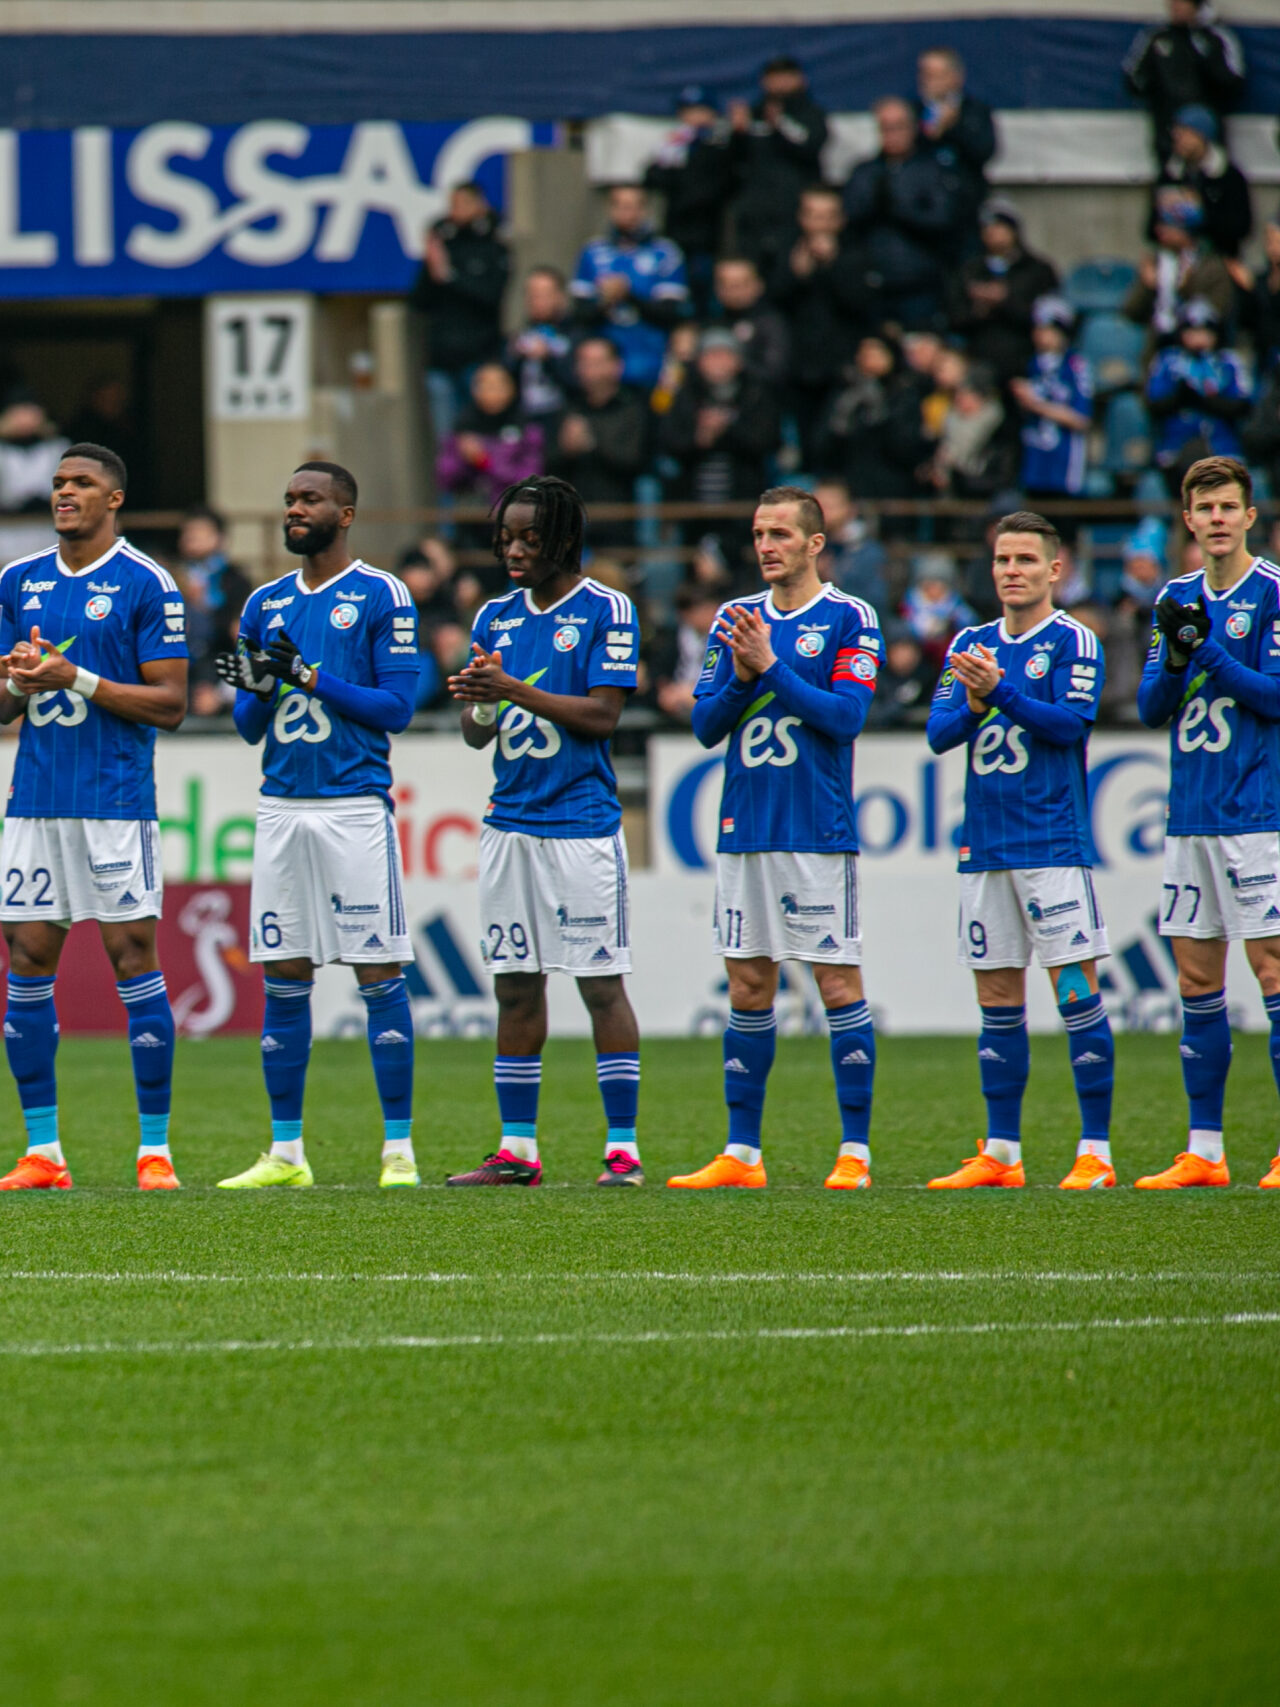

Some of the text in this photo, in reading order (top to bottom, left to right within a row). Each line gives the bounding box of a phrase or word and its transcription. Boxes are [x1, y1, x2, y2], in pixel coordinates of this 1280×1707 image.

[223, 315, 293, 378] 17
[741, 716, 802, 768] es
[1177, 697, 1236, 753] es
[972, 724, 1029, 776] es
[5, 868, 54, 906] 22
[1163, 884, 1201, 923] 77
[260, 911, 282, 948] 6
[487, 922, 529, 961] 29
[725, 908, 742, 949] 11
[968, 920, 988, 958] 9
